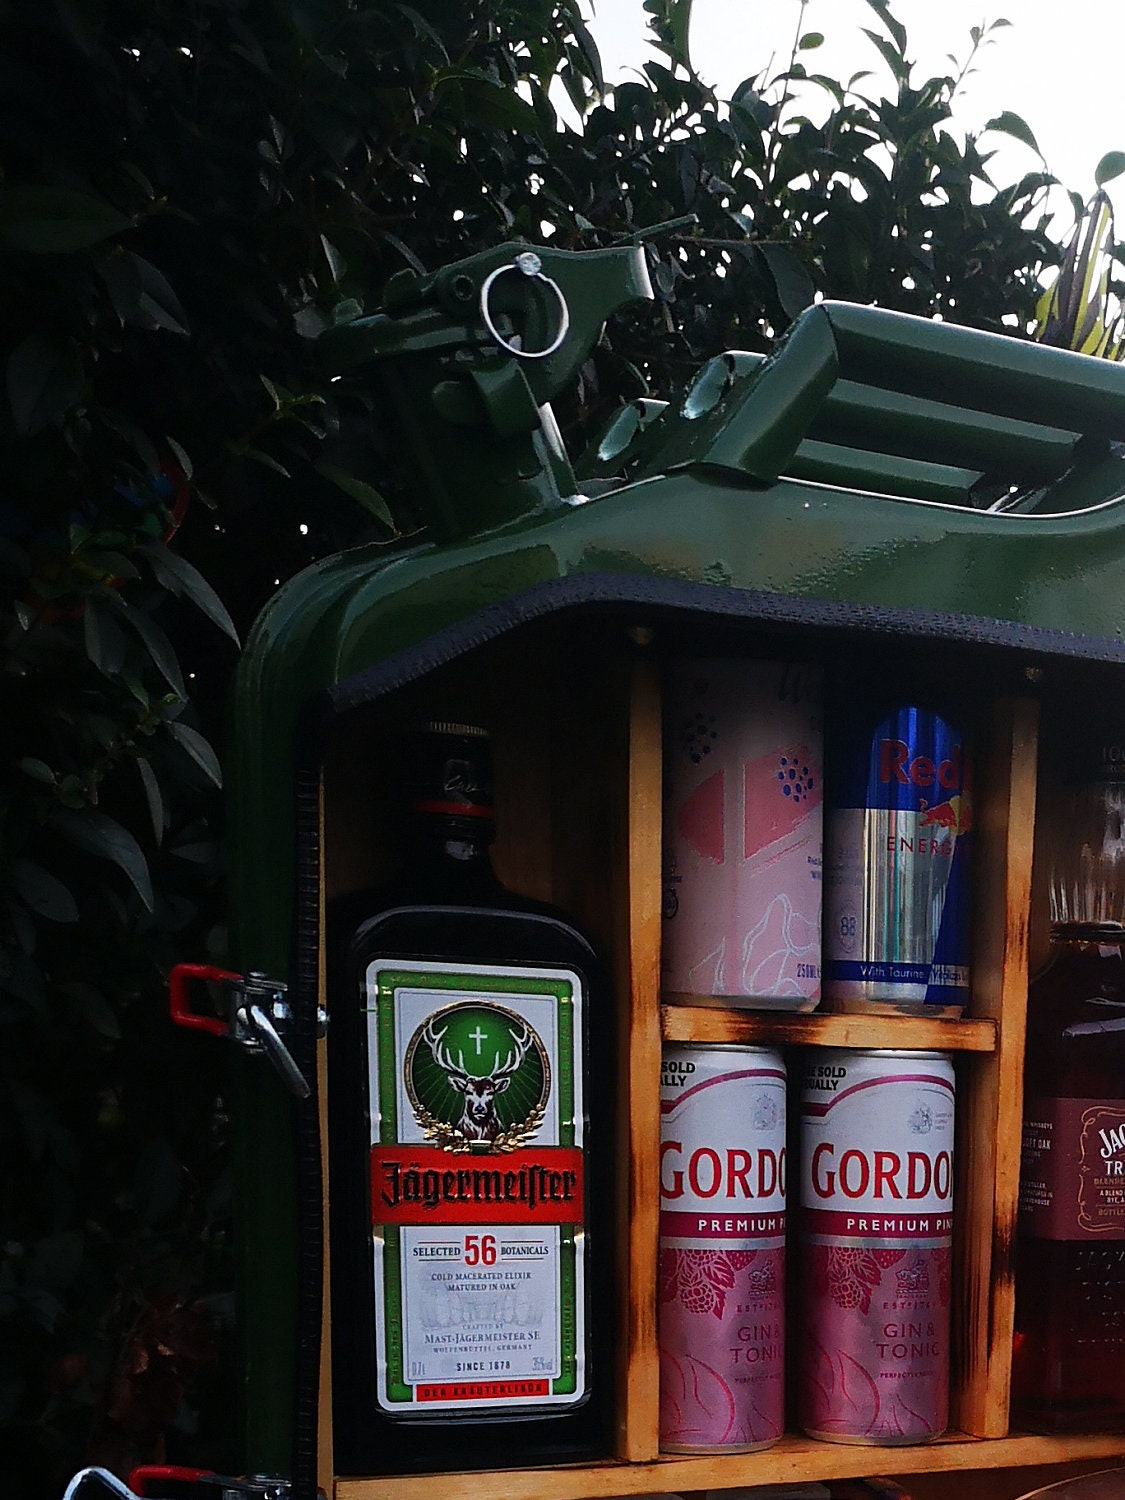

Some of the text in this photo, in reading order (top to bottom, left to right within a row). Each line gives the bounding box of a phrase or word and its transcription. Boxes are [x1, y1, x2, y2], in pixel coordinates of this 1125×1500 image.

[880, 738, 960, 789] Red
[860, 965, 885, 977] With
[661, 1061, 696, 1073] SOLD
[817, 1066, 846, 1078] SOLD
[811, 1142, 953, 1200] GORDO
[698, 1217, 776, 1232] PREMIUM
[846, 1218, 930, 1232] PREMIUM
[412, 1234, 549, 1266] SELECTED 56 BOTANICALS
[431, 1271, 532, 1280] COLD MACERATED ELIXIR
[447, 1282, 516, 1291] MATURED IN OAK
[737, 1324, 771, 1342] GIN
[883, 1321, 935, 1338] GIN &
[875, 1341, 940, 1359] TONIC
[456, 1360, 511, 1372] SINCE 1878
[423, 1387, 446, 1398] DER
